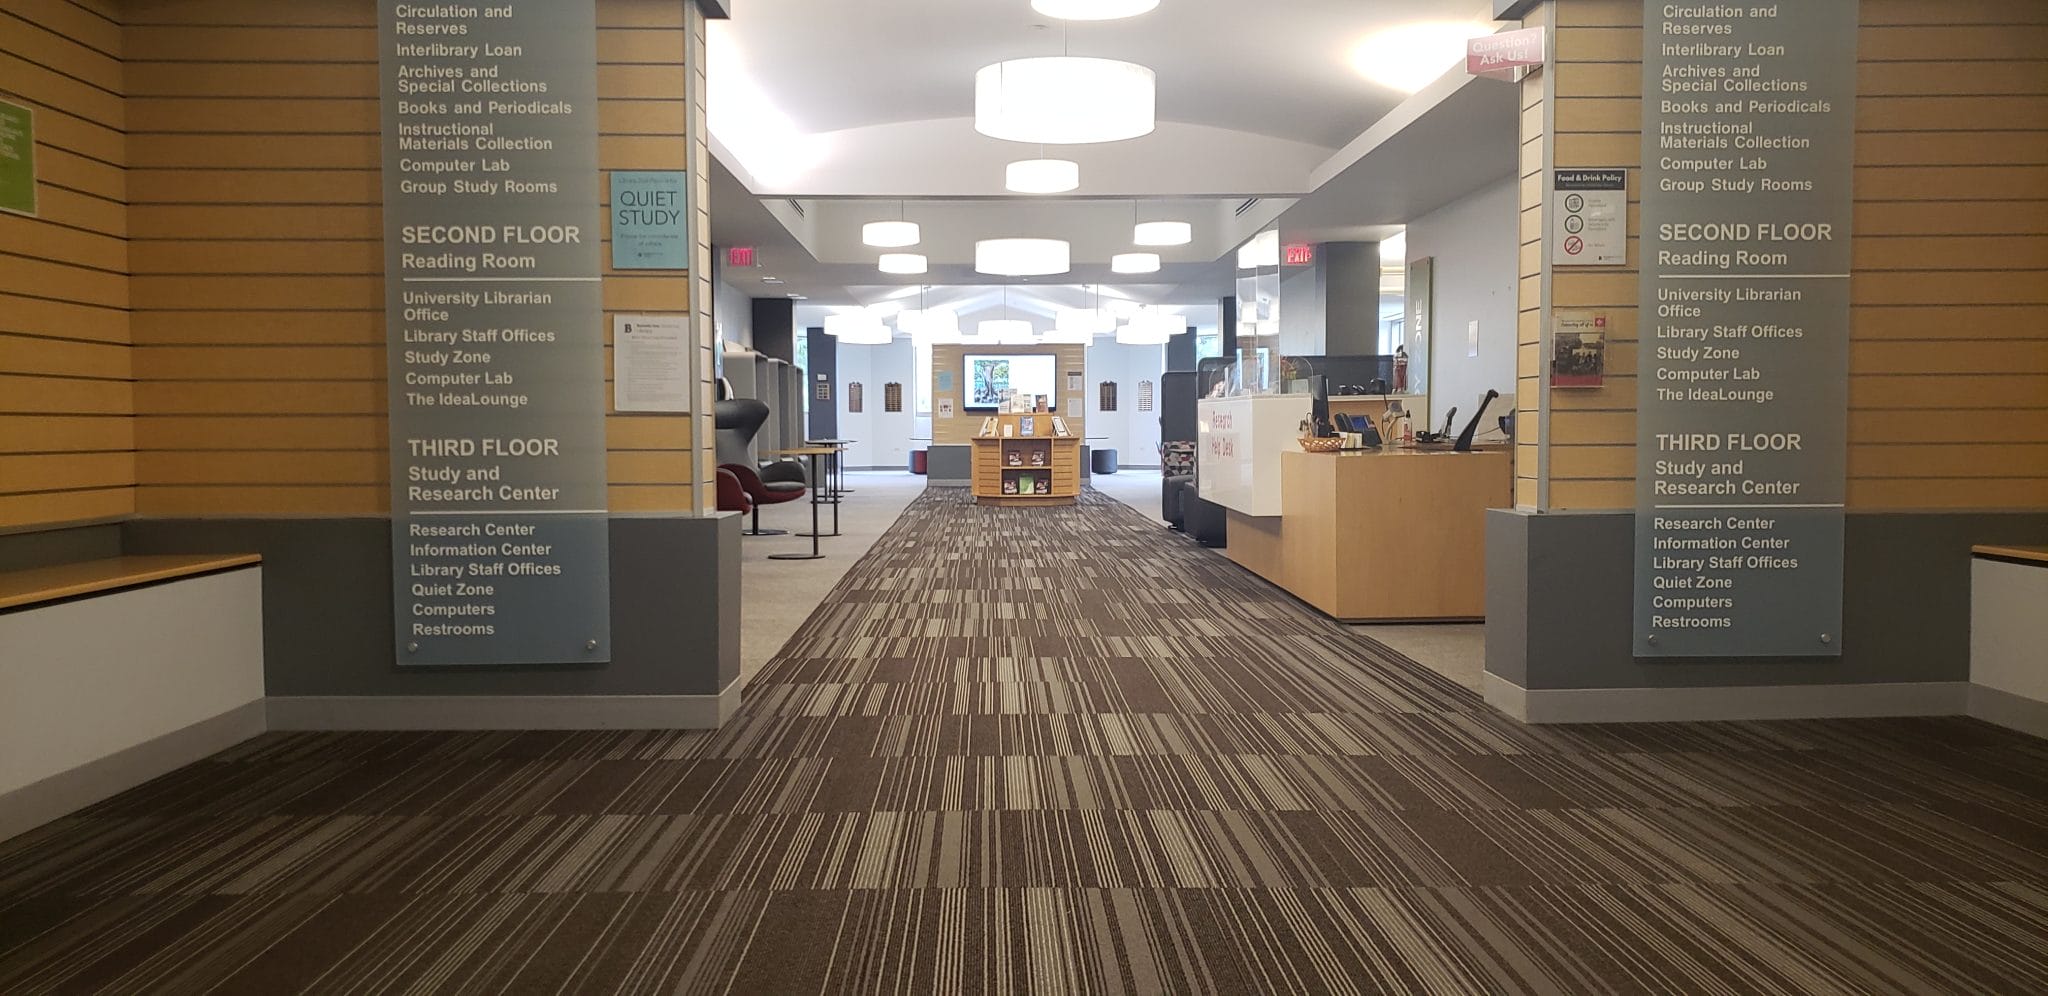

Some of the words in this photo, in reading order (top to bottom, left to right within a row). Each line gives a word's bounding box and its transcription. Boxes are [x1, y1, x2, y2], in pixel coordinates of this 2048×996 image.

[396, 5, 477, 18] Circulation
[484, 5, 512, 18] and
[1663, 5, 1743, 18] Circulation
[1750, 5, 1777, 18] and
[396, 22, 467, 35] Reserves
[1662, 22, 1732, 35] Reserves
[397, 43, 479, 59] Interlibrary
[485, 43, 522, 57] Loan
[1480, 52, 1504, 65] Ask
[1508, 48, 1528, 61] Us!
[1662, 43, 1742, 58] Interlibrary
[1748, 43, 1784, 56] Loan
[398, 65, 463, 78] Archives
[470, 65, 498, 78] and
[1662, 65, 1726, 78] Archives
[1732, 65, 1760, 78] and
[398, 80, 455, 94] Special
[461, 80, 547, 93] Collections
[1662, 79, 1717, 94] Special
[1723, 79, 1807, 92] Collections
[398, 101, 447, 115] Books
[454, 101, 482, 115] and
[489, 101, 572, 115] Periodicals
[1661, 100, 1708, 114] Books
[1715, 100, 1742, 114] and
[1749, 100, 1831, 113] Periodicals
[399, 123, 493, 136] Instructional
[1660, 122, 1753, 135] Instructional
[399, 137, 469, 150] Materials
[475, 137, 553, 150] Collection
[1660, 136, 1728, 149] Materials
[1734, 136, 1809, 149] Collection
[400, 159, 475, 173] Computer
[482, 159, 510, 172] Lab
[1660, 157, 1733, 172] Computer
[1740, 157, 1767, 170] Lab
[1557, 174, 1574, 182] Food
[1582, 173, 1601, 182] Drink
[1602, 173, 1622, 183] Policy
[1660, 179, 1705, 193] Group
[1711, 178, 1754, 193] Study
[1761, 178, 1813, 192] Rooms
[401, 180, 447, 195] Group
[454, 180, 498, 195] Study
[505, 180, 558, 194] Rooms
[620, 190, 678, 207] QUIET
[619, 209, 680, 226] STUDY
[402, 226, 496, 244] SECOND
[503, 226, 580, 244] FLOOR
[1659, 224, 1751, 242] SECOND
[1757, 223, 1832, 241] FLOOR
[402, 253, 476, 271] Reading
[482, 253, 535, 269] Room
[1287, 247, 1309, 263] EXIT
[1658, 251, 1730, 268] Reading
[1736, 250, 1787, 265] Room
[404, 292, 479, 307] University
[484, 292, 551, 305] Librarian
[1658, 288, 1731, 303] University
[1736, 288, 1801, 301] Librarian
[404, 308, 449, 321] Office
[1658, 305, 1701, 318] Office
[624, 323, 632, 334] B
[1657, 326, 1708, 341] Library
[1713, 325, 1748, 338] Staff
[1751, 325, 1803, 338] Offices
[404, 329, 457, 345] Library
[462, 329, 498, 343] Staff
[501, 329, 555, 343] Offices
[405, 351, 449, 366] Study
[453, 351, 491, 364] Zone
[1657, 347, 1699, 362] Study
[1703, 346, 1740, 359] Zone
[405, 372, 481, 387] Computer
[485, 372, 513, 385] Lab
[1656, 367, 1729, 382] Computer
[1733, 367, 1760, 380] Lab
[406, 392, 435, 406] The
[439, 392, 528, 408] IdeaLounge
[1657, 388, 1684, 401] The
[1688, 388, 1774, 403] IdeaLounge
[408, 439, 475, 457] THIRD
[482, 439, 559, 456] FLOOR
[1222, 437, 1234, 457] Desk
[1656, 434, 1720, 451] THIRD
[1727, 433, 1801, 451] FLOOR
[408, 466, 461, 484] Study
[466, 466, 500, 481] and
[1655, 461, 1706, 478] Study
[1711, 460, 1743, 475] and
[409, 486, 493, 501] Research
[499, 486, 559, 500] Center
[1655, 481, 1736, 495] Research
[1741, 480, 1800, 495] Center
[410, 524, 481, 536] Research
[485, 523, 535, 536] Center
[1654, 517, 1722, 530] Research
[1726, 517, 1775, 530] Center
[410, 543, 497, 556] Information
[501, 543, 551, 555] Center
[1654, 536, 1737, 550] Information
[1741, 536, 1790, 549] Center
[411, 563, 464, 579] Library
[468, 563, 504, 576] Staff
[507, 562, 561, 575] Offices
[1653, 556, 1705, 571] Library
[1708, 556, 1743, 569] Staff
[1746, 556, 1798, 568] Offices
[412, 583, 452, 597] Quiet
[456, 583, 494, 596] Zone
[1653, 576, 1692, 590] Quiet
[1696, 576, 1732, 589] Zone
[412, 603, 495, 618] Computers
[1653, 596, 1733, 611] Computers
[413, 623, 495, 636] Restrooms
[1653, 616, 1731, 628] Restrooms
